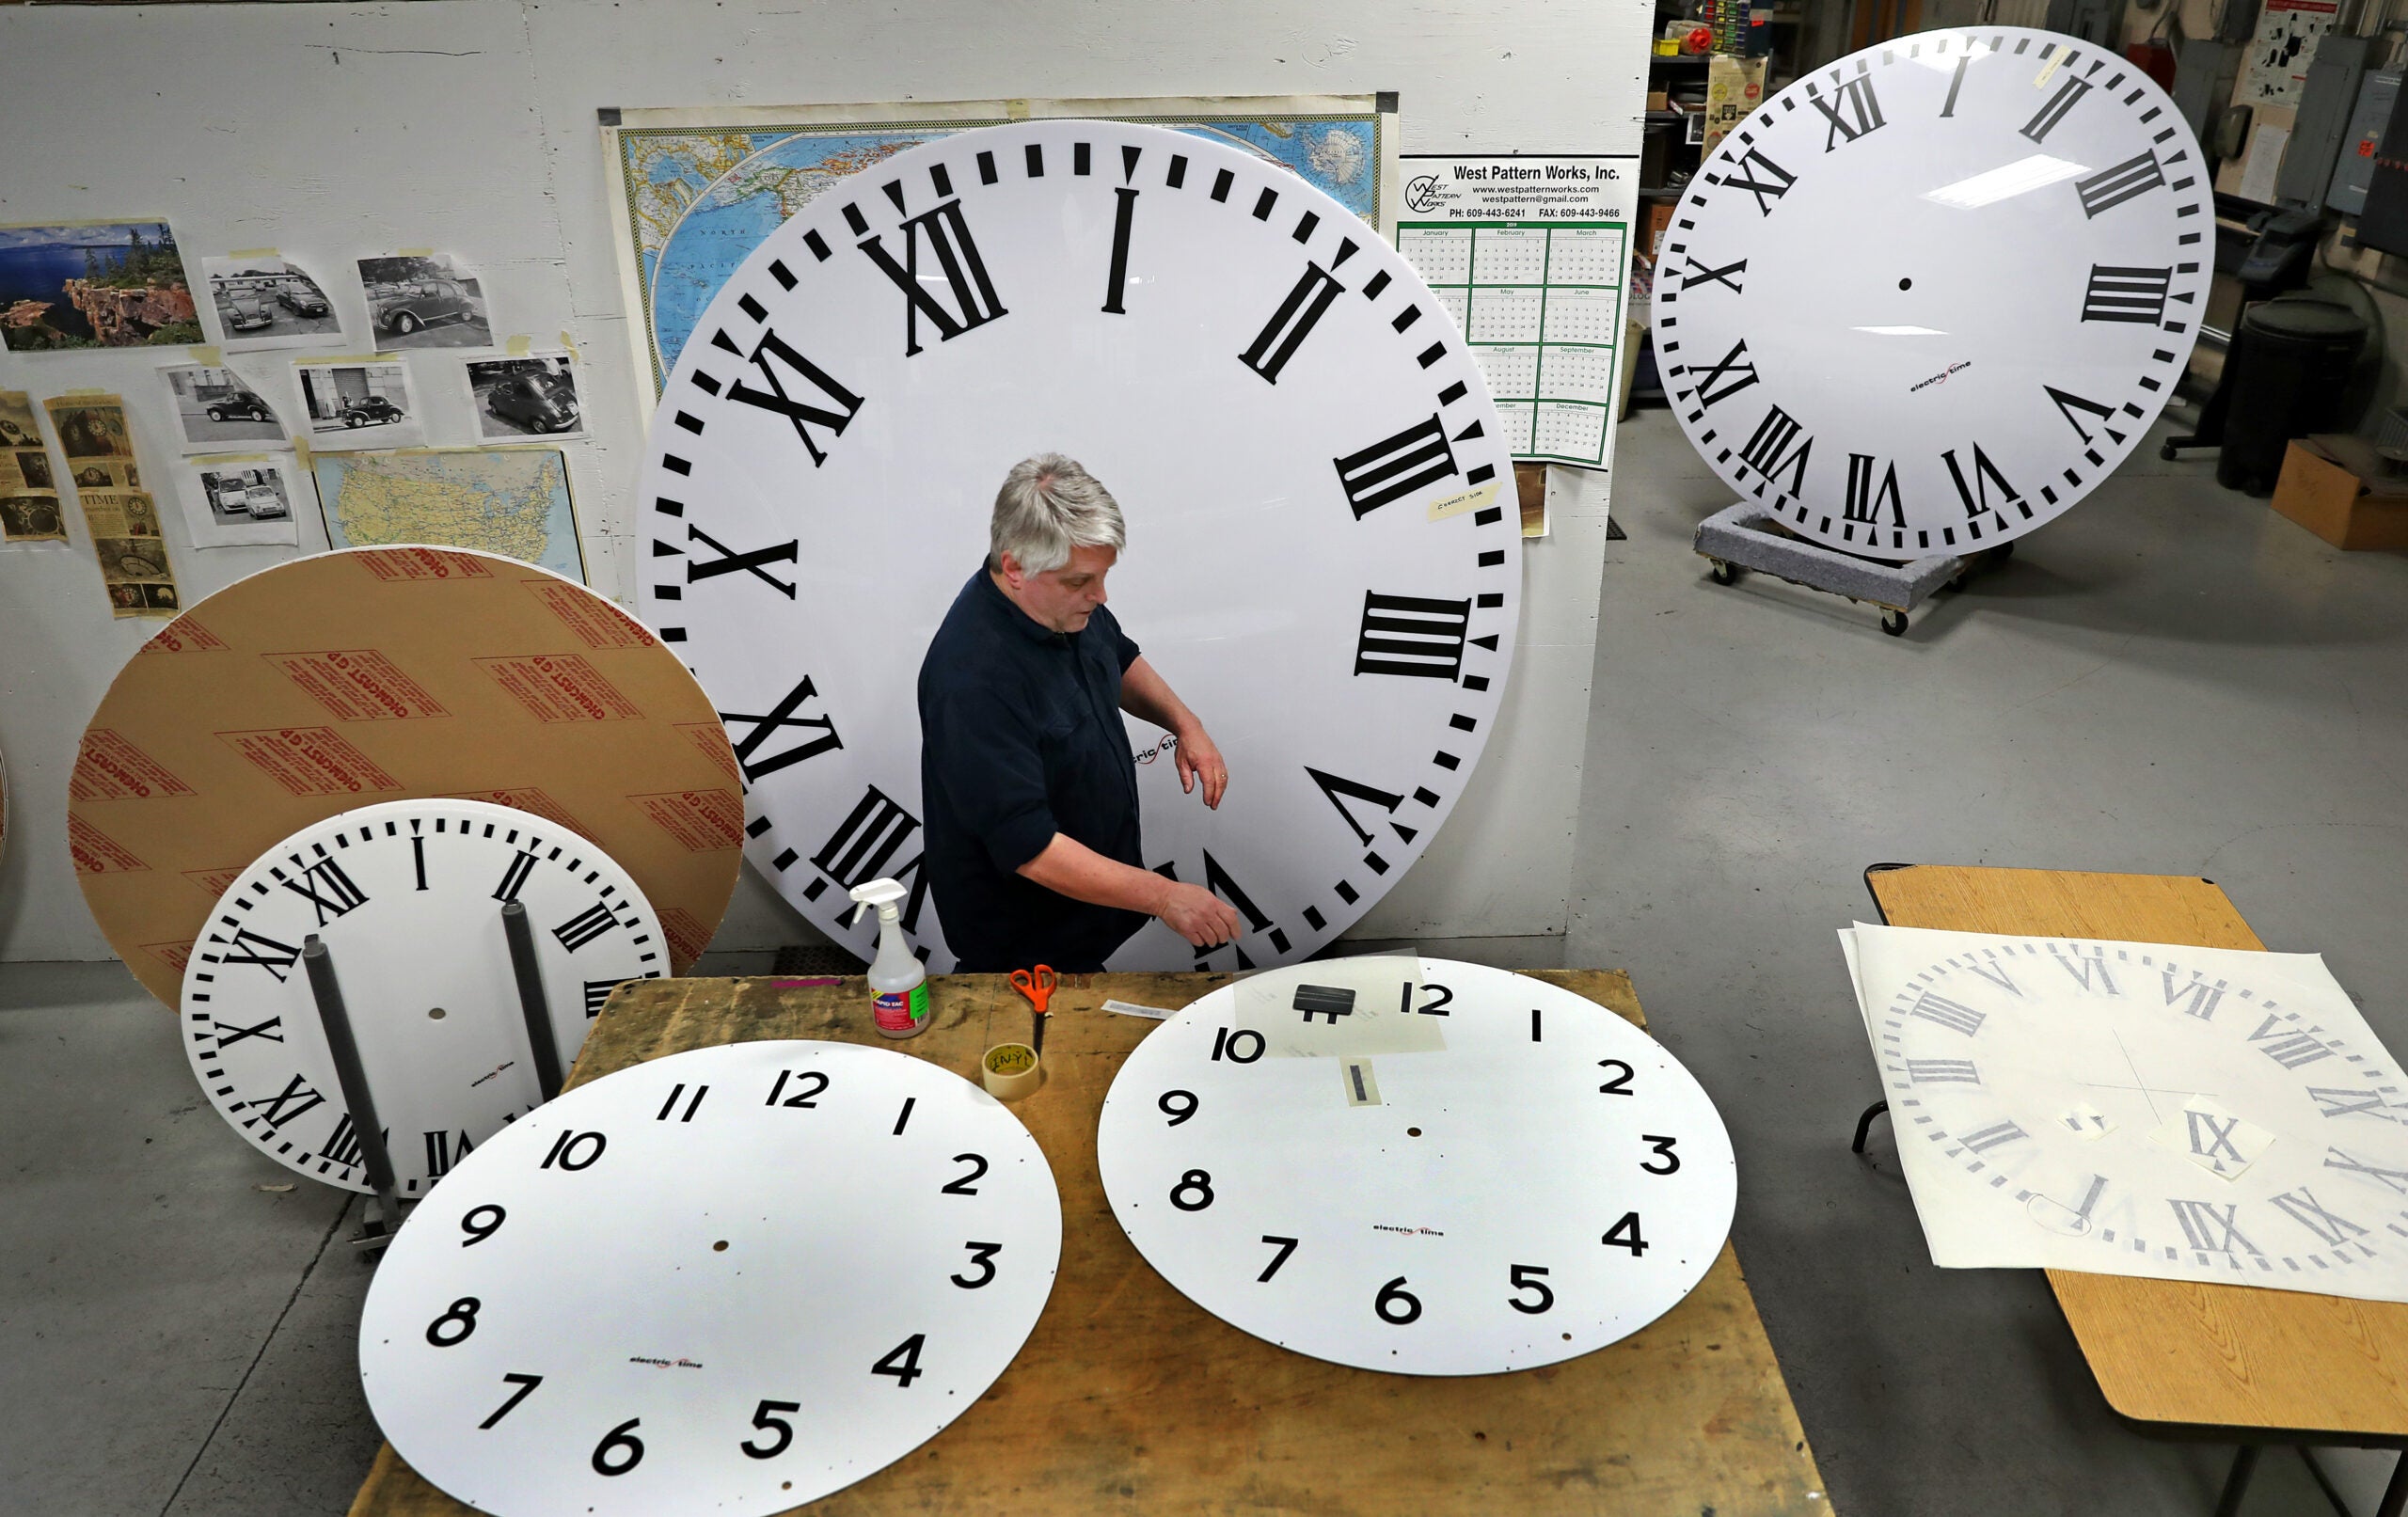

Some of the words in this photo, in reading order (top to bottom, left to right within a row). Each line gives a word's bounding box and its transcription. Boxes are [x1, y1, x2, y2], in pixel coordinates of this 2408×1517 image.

[1940, 55, 1972, 118] I
[2019, 75, 2094, 144] II
[1806, 71, 1886, 153] XII
[1453, 166, 1487, 180] West
[1492, 166, 1542, 180] Pattern
[1545, 166, 1590, 182] Works,
[1594, 166, 1620, 180] Inc.
[1472, 185, 1600, 195] www.westpatternworks.com
[1720, 147, 1798, 217] XI
[2075, 148, 2166, 219] III
[1450, 208, 1465, 218] PH:
[1466, 208, 1526, 218] 609-443-6241
[1538, 208, 1559, 218] FAX:
[1560, 208, 1620, 218] 609-443-9466
[1481, 195, 1589, 204] westpattern@gmail.com
[1101, 187, 1139, 314] I
[857, 198, 1008, 357] XII
[2081, 263, 2173, 327] IIII
[1238, 261, 1346, 386] II
[1560, 346, 1595, 355] September
[725, 327, 864, 468] XI
[1910, 372, 1947, 392] electric
[1949, 361, 1972, 374] time
[1556, 403, 1589, 412] December
[1333, 412, 1459, 521] III
[1354, 590, 1471, 683] IIII
[411, 837, 428, 891] I
[492, 849, 540, 902] II
[282, 854, 370, 927] XII
[552, 901, 620, 954] III
[222, 928, 302, 983] XI
[1401, 982, 1452, 1016] 12
[1212, 1027, 1265, 1064] 10
[1532, 1010, 1541, 1042] 1
[766, 1070, 829, 1108] 12
[1598, 1060, 1634, 1096] 2
[657, 1084, 708, 1122] 11
[893, 1098, 915, 1135] 1
[1159, 1090, 1198, 1127] 9
[541, 1130, 606, 1171] 10
[1640, 1135, 1680, 1175] 3
[942, 1154, 988, 1195] 2
[1170, 1169, 1214, 1211] 8
[462, 1205, 506, 1247] 9
[1373, 1225, 1413, 1233] electric
[1420, 1228, 1444, 1237] time
[1602, 1212, 1648, 1256] 4
[951, 1241, 1002, 1288] 3
[1258, 1236, 1298, 1282] 7
[1375, 1276, 1421, 1325] 6
[1509, 1264, 1554, 1314] 5
[426, 1297, 481, 1347] 8
[630, 1356, 671, 1366] electric
[871, 1334, 926, 1387] 4
[479, 1373, 543, 1430] 7
[592, 1417, 644, 1477] 6
[741, 1399, 800, 1459] 5
